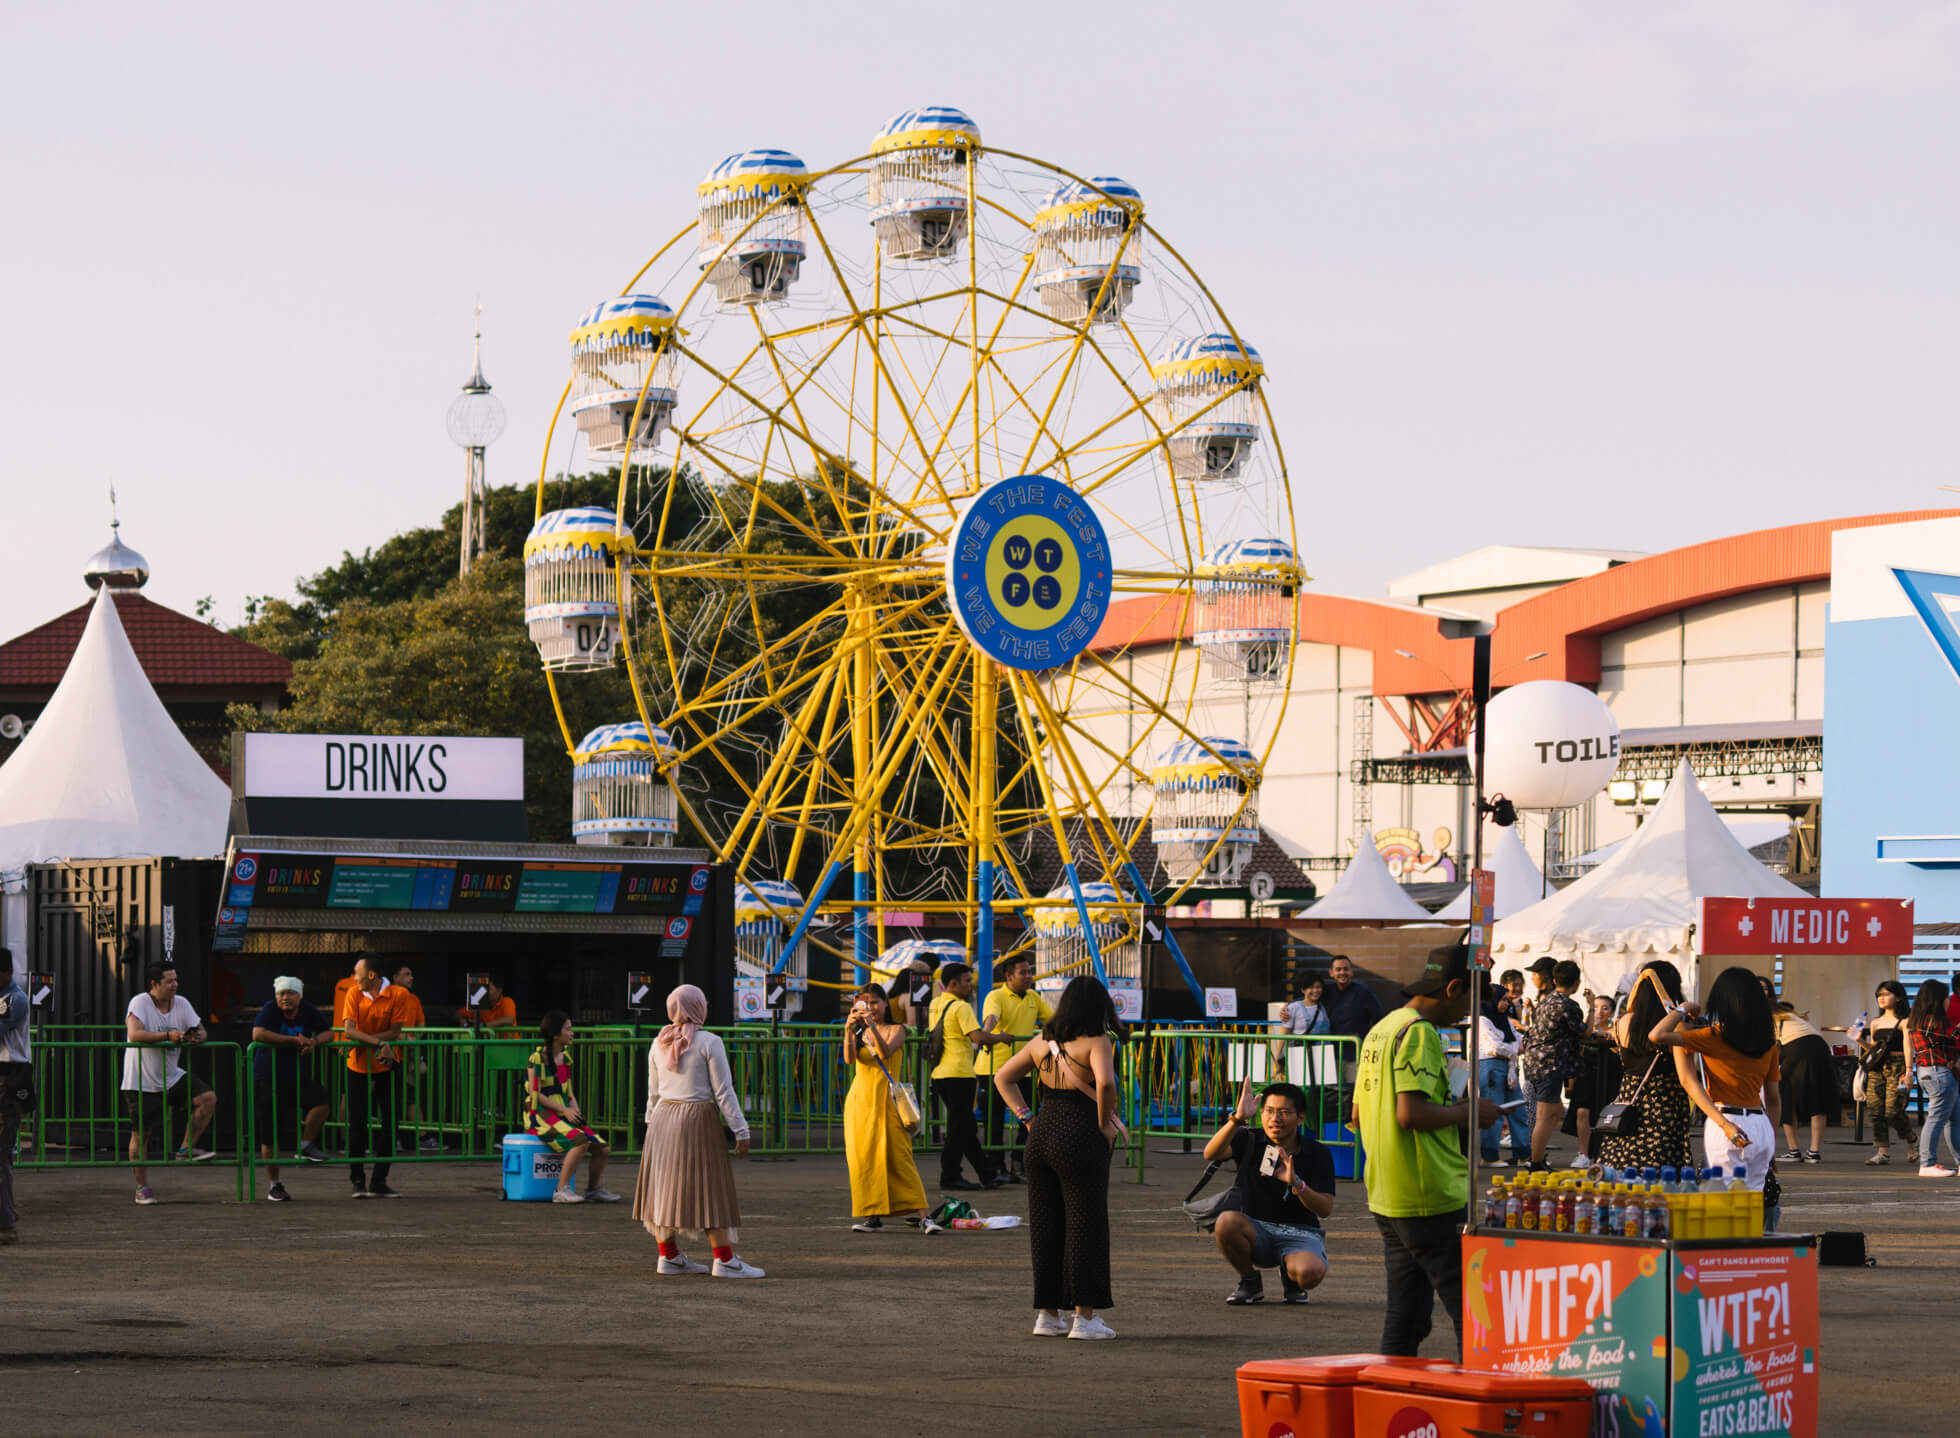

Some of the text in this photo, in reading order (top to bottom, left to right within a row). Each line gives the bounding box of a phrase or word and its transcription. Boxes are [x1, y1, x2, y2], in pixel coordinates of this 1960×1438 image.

[961, 485, 1105, 562] WE THE FEST
[964, 582, 1104, 660] WE THE FEST
[578, 625, 609, 652] 08
[1534, 734, 1620, 764] TOILE
[326, 742, 447, 793] DRINKS
[268, 868, 321, 886] DRINKS
[461, 873, 513, 890] DRINKS
[629, 877, 678, 894] DRINKS
[1771, 909, 1850, 944] MEDIC
[1500, 1259, 1613, 1345] WTF?!
[1698, 1282, 1790, 1356] WTF?!
[1502, 1339, 1625, 1373] where's the food
[1744, 1355, 1763, 1374] the
[1766, 1344, 1797, 1372] food
[1700, 1390, 1793, 1437] EATS&BEATS
